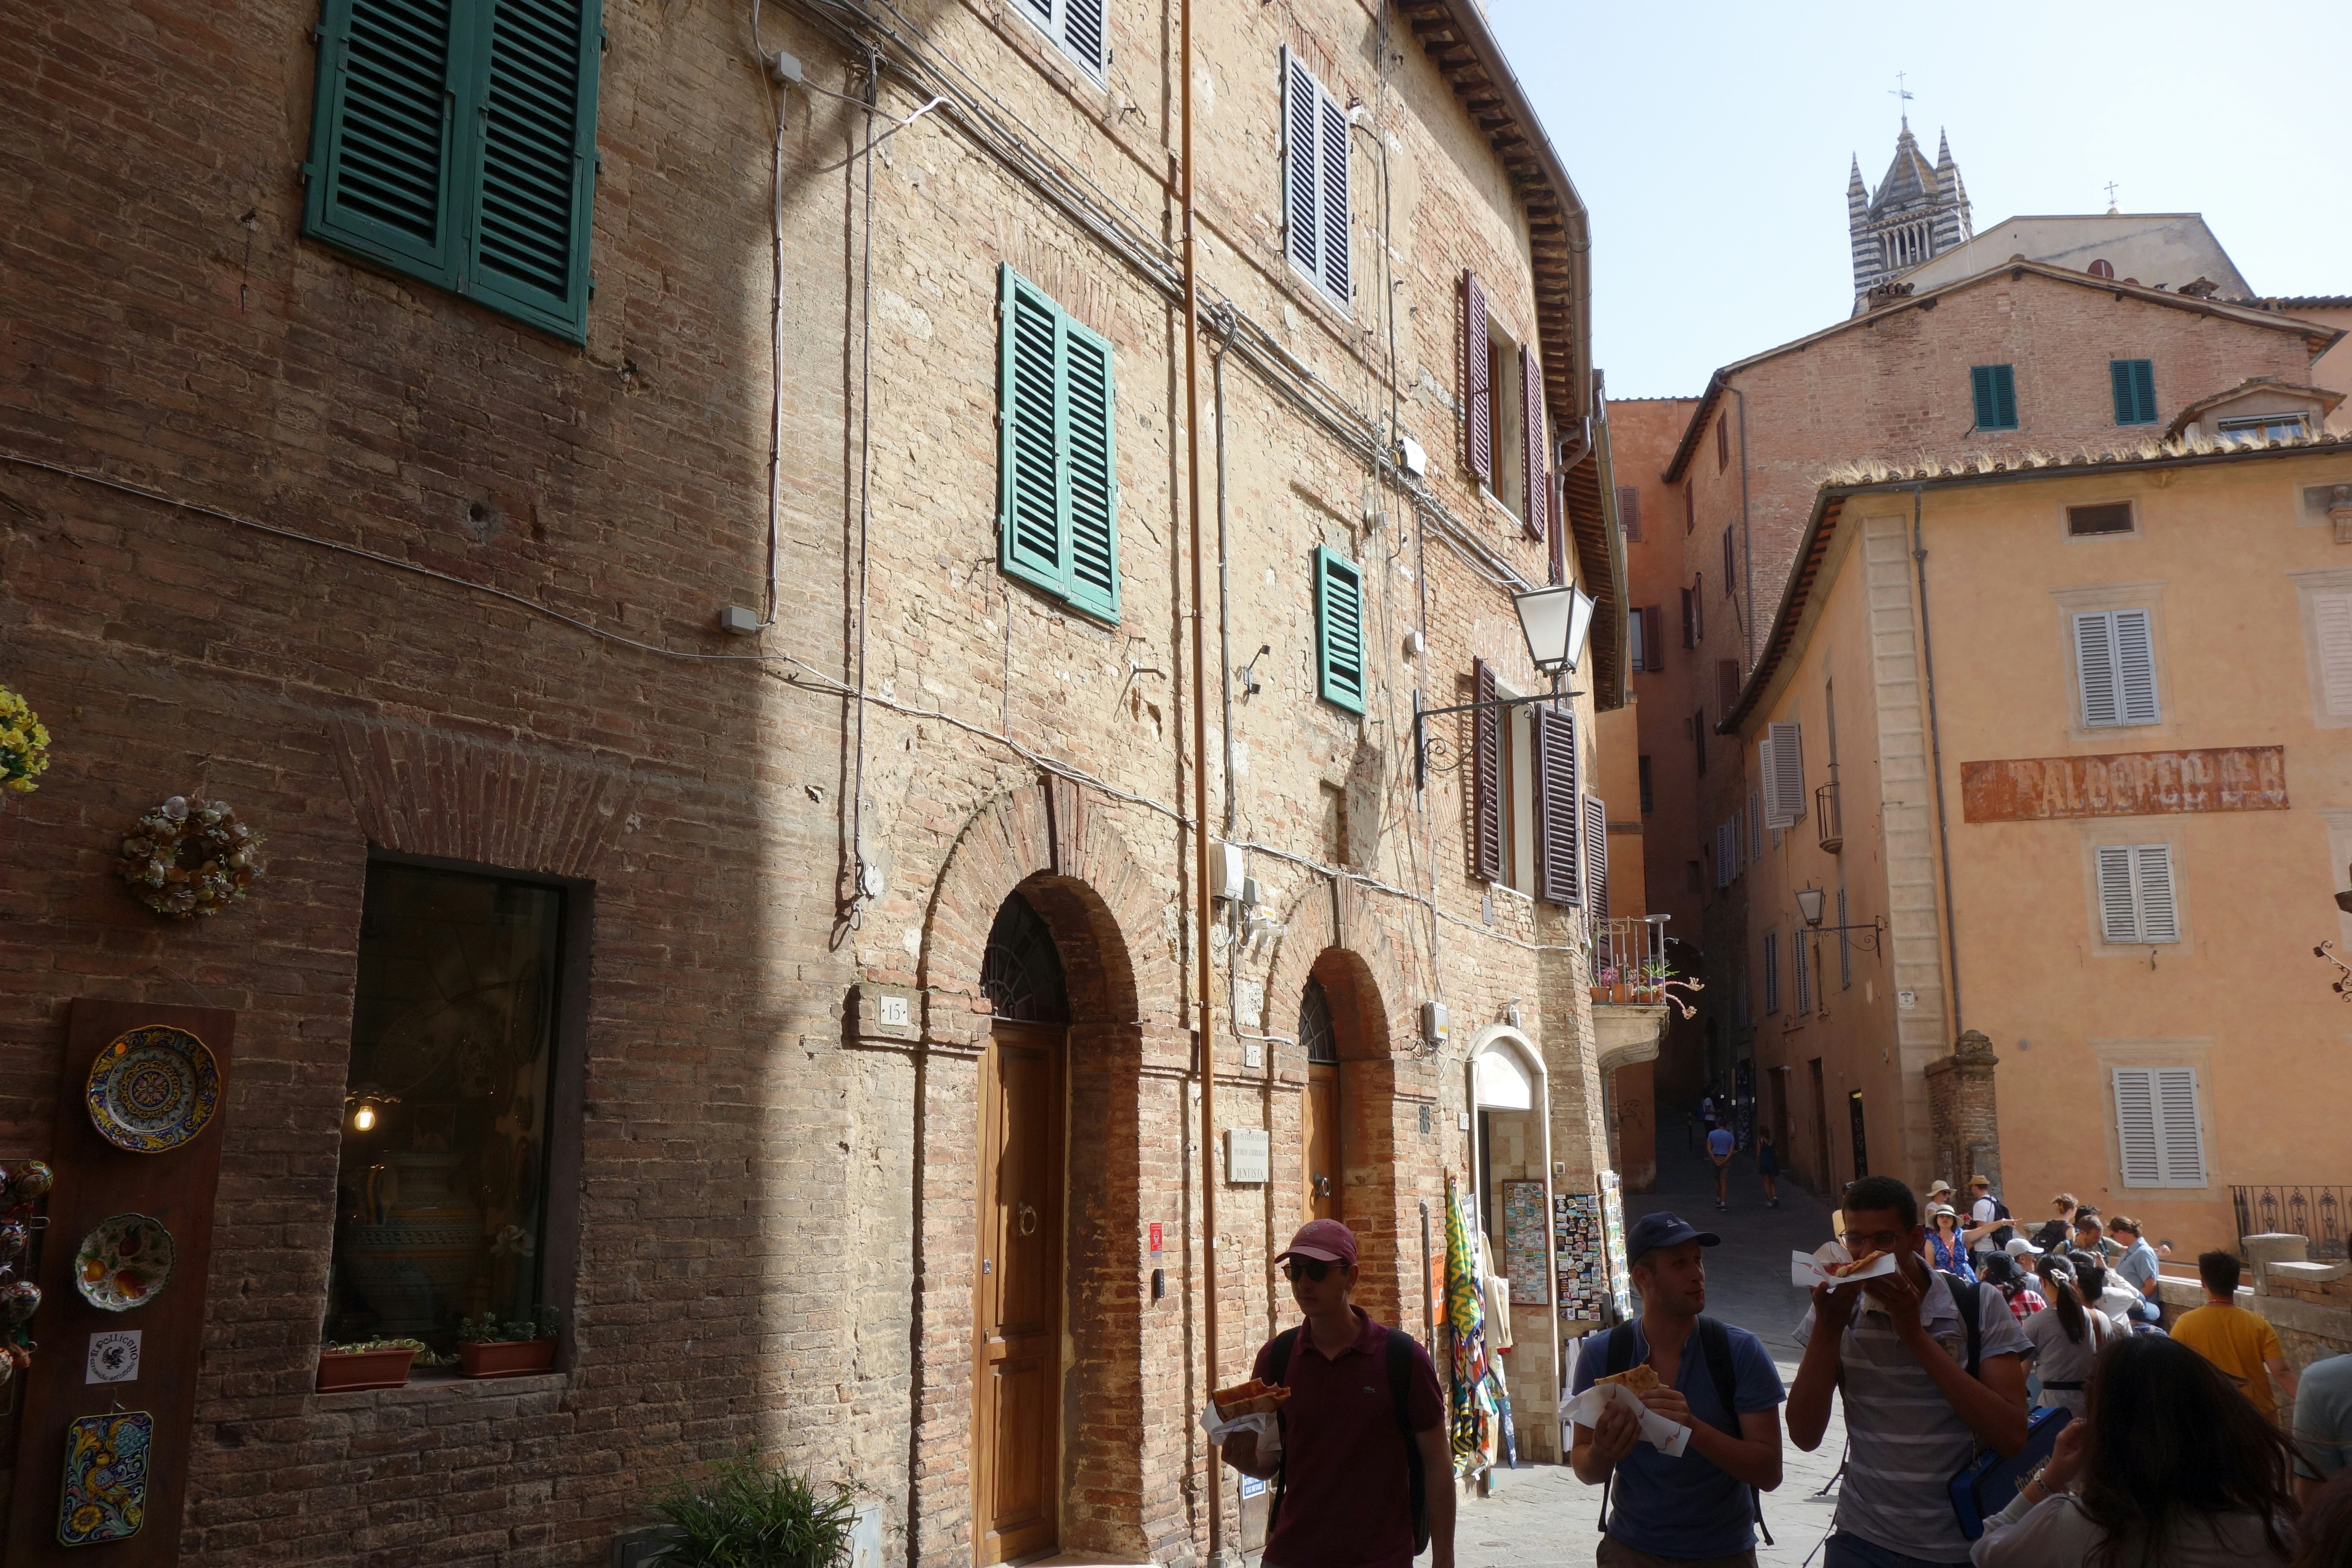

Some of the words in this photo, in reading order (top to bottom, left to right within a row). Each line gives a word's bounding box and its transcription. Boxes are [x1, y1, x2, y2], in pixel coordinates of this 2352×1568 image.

[888, 1003, 900, 1020] 15
[1251, 1050, 1257, 1063] 17
[1462, 1116, 1467, 1127] 17
[1255, 1134, 1268, 1142] STEFANO
[1236, 1168, 1264, 1179] DENTISTA
[96, 1333, 138, 1360] Pellicano
[1251, 1483, 1262, 1493] METANO
